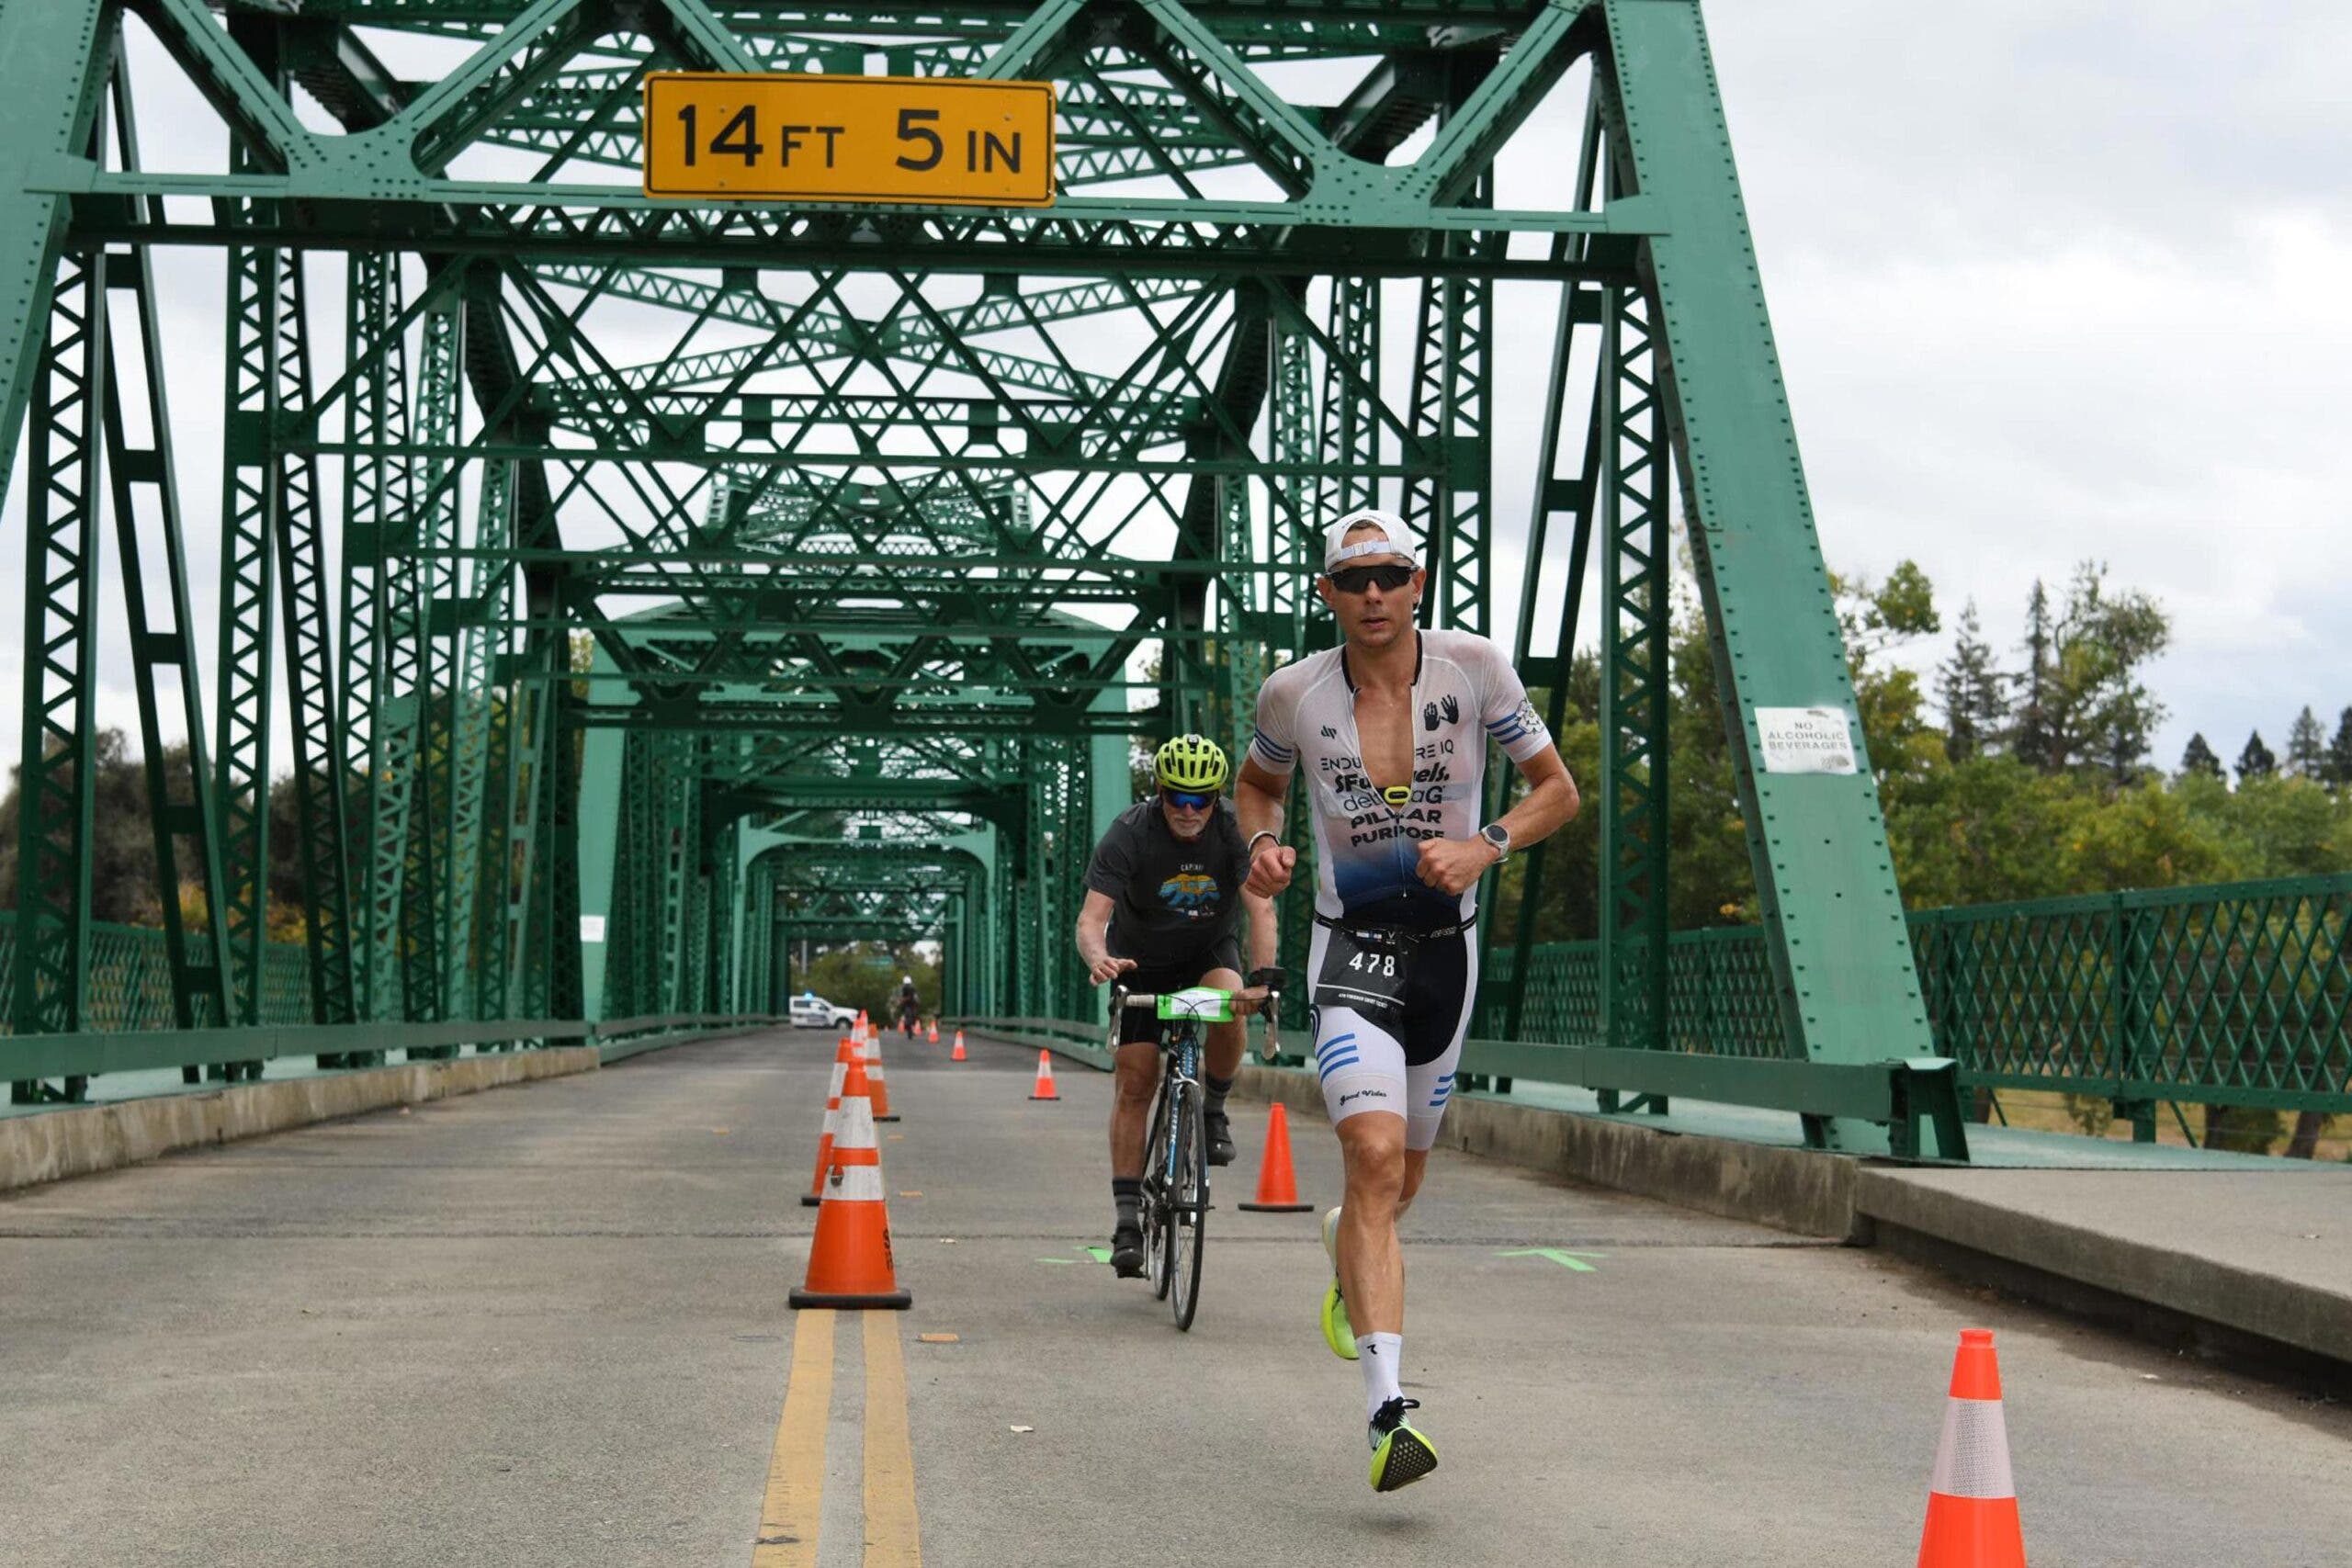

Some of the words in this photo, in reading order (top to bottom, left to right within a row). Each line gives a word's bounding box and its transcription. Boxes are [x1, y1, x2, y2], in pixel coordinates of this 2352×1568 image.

[678, 104, 763, 167] 14
[781, 126, 844, 168] FT
[896, 108, 944, 172] 5
[967, 130, 1021, 174] IN
[1794, 722, 1813, 730] NO
[1768, 732, 1844, 740] ALCOHOLIC
[1440, 739, 1454, 754] IQ
[1768, 741, 1848, 750] BEVERAGES
[1351, 825, 1445, 847] PURPOSE
[1348, 952, 1396, 977] 478
